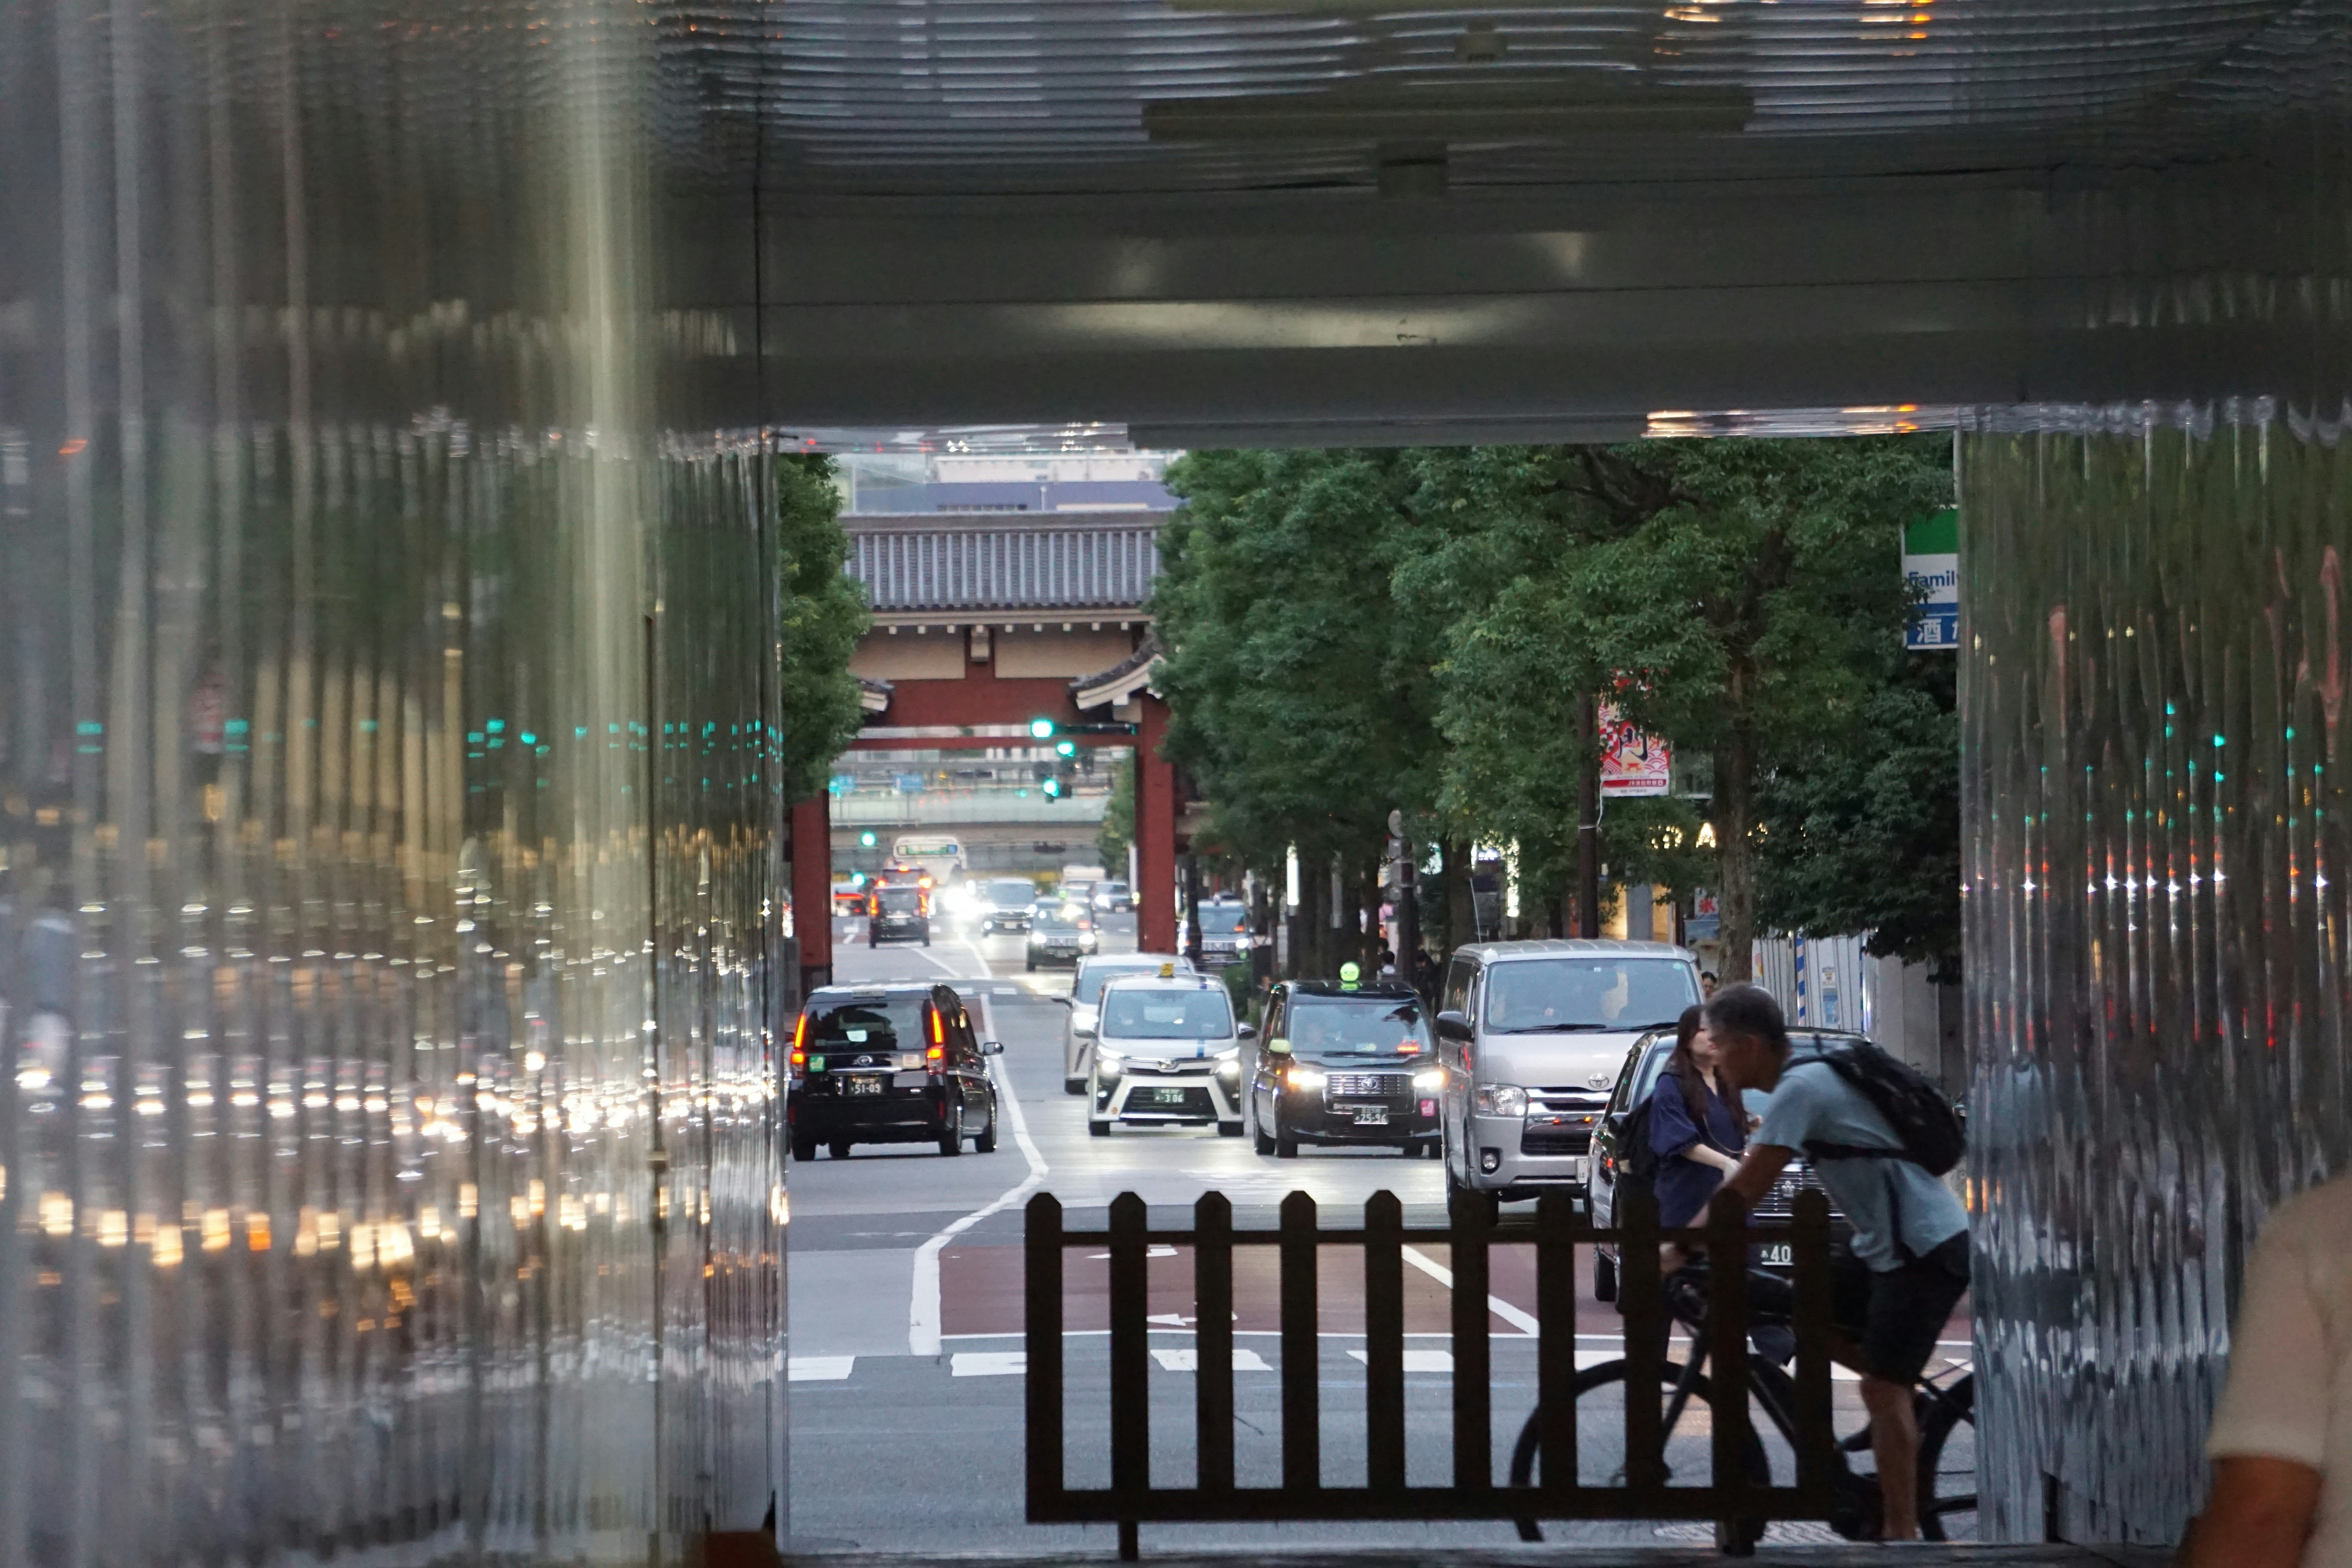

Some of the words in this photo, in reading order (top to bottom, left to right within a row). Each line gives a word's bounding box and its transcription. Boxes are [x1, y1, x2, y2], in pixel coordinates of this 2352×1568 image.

[1909, 570, 1958, 587] Famil
[855, 1083, 881, 1094] 51-09
[1770, 1245, 1791, 1262] 40
